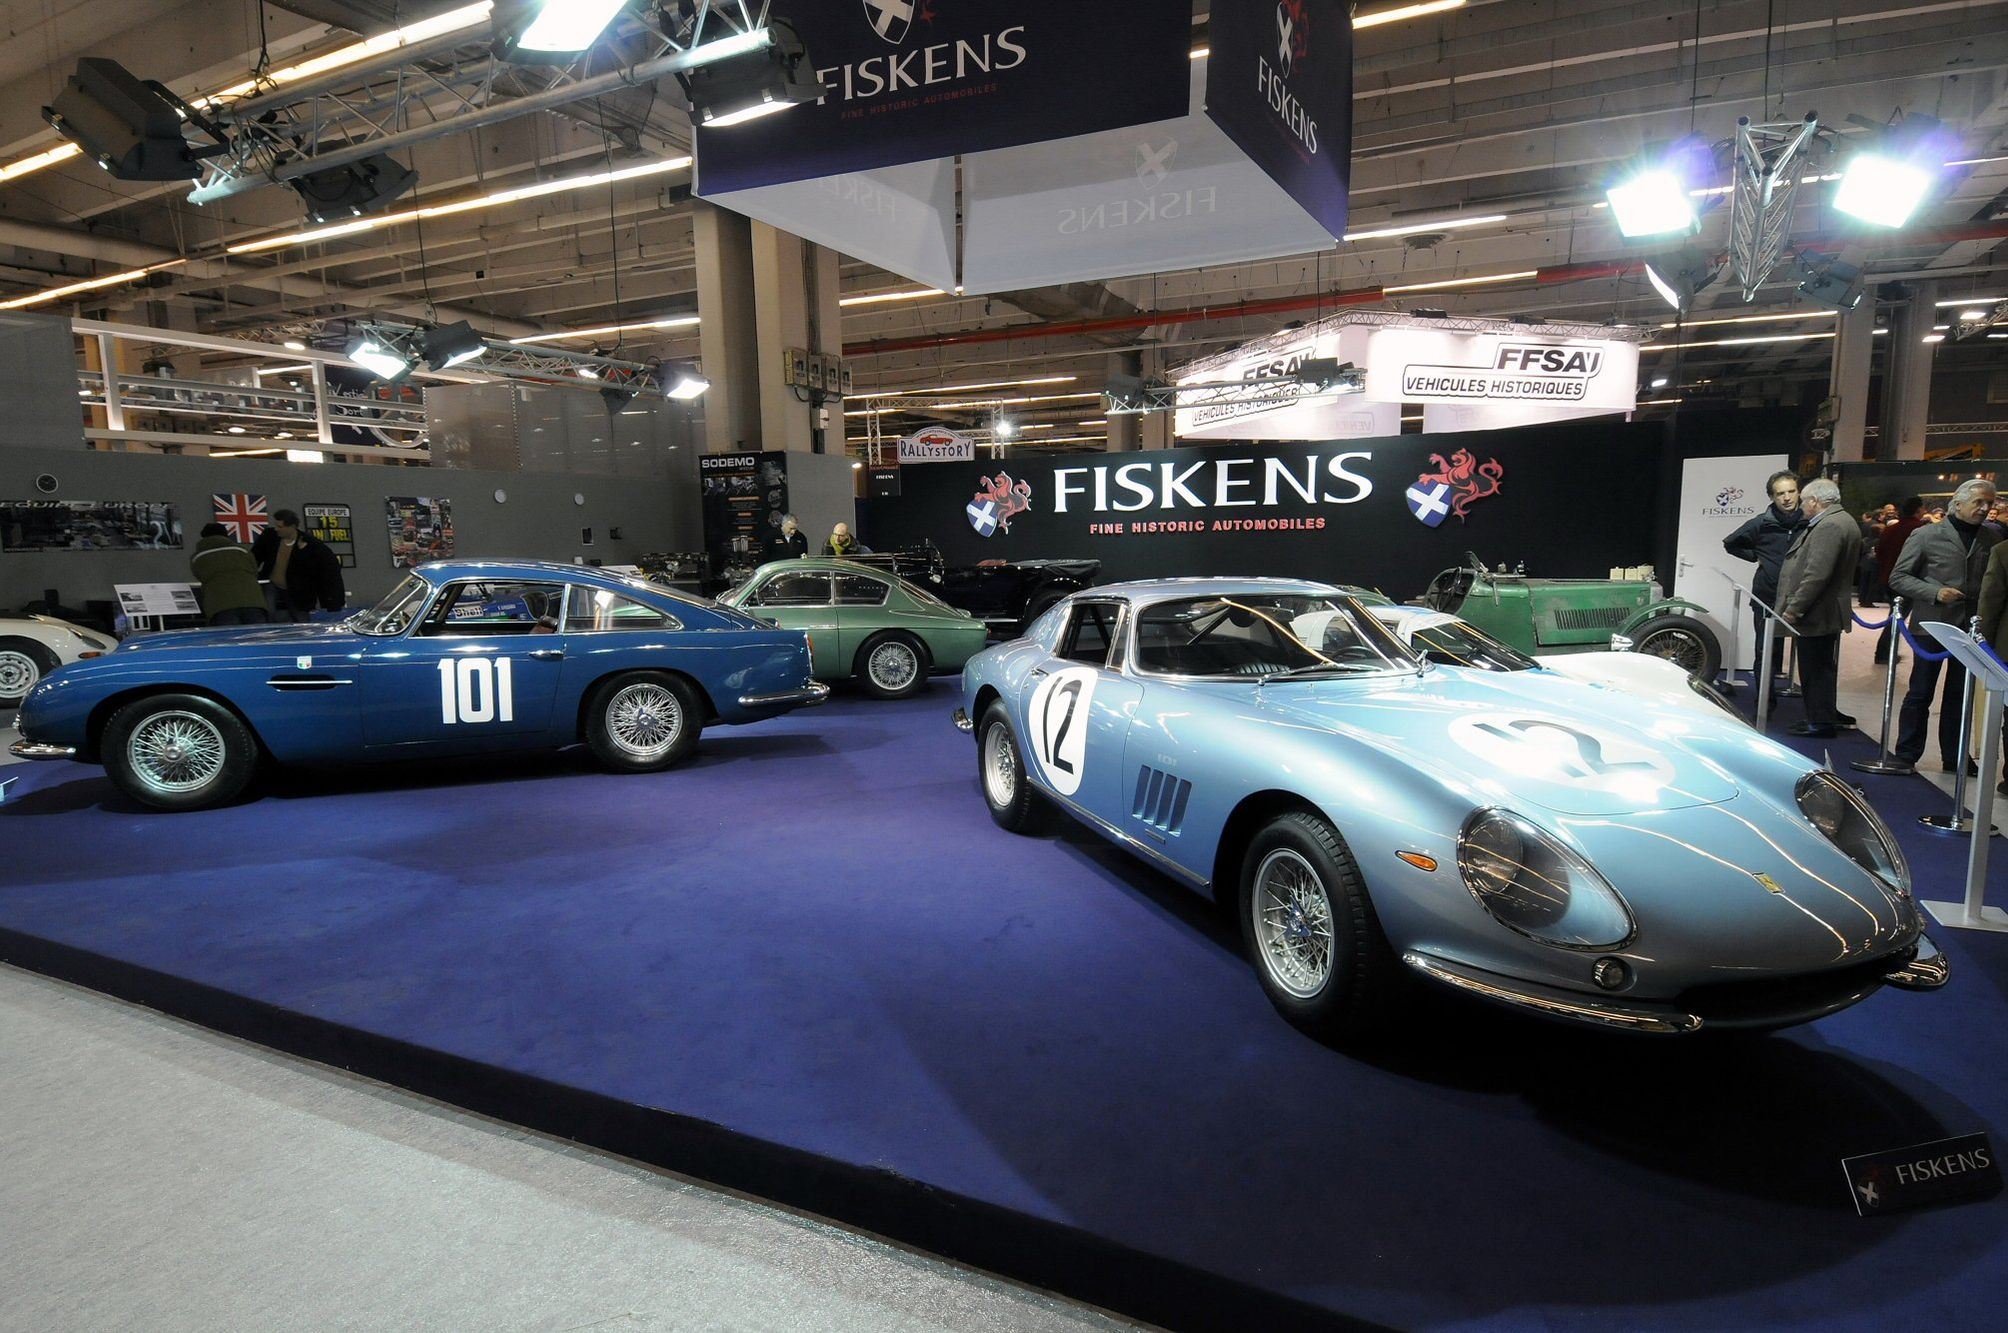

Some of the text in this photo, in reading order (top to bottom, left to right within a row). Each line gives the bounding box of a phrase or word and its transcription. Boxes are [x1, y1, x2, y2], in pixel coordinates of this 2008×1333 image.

[816, 25, 1027, 106] FISKENS
[1258, 55, 1318, 154] FISKENS
[1407, 376, 1583, 396] VEHICULES HISTORIQUES
[702, 457, 755, 468] SODEMO
[900, 440, 971, 457] RALLYSTORY
[1053, 451, 1374, 513] FISKENS
[1089, 517, 1326, 534] FINE HISTORIC AUTOMOBILES
[1702, 506, 1755, 515] FISKENS
[437, 657, 513, 724] 101
[1043, 676, 1082, 775] 12
[1895, 1148, 1990, 1185] FISKENS
